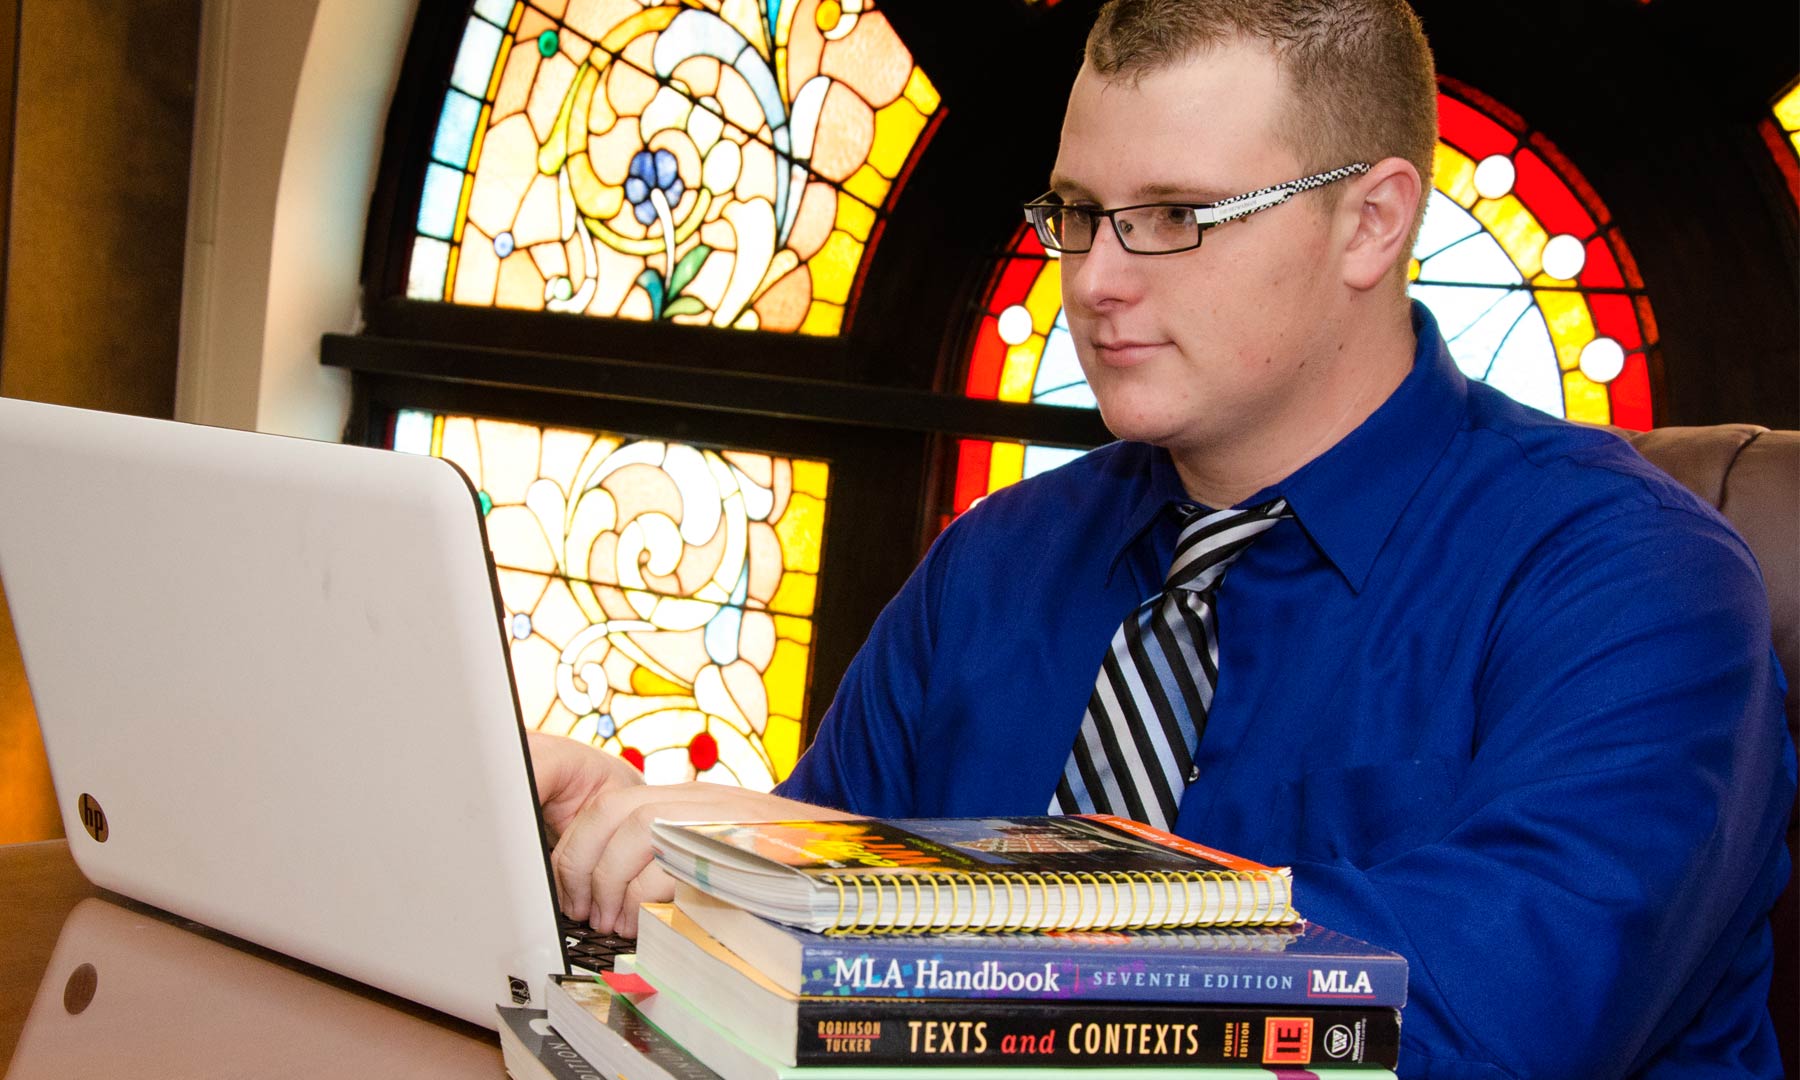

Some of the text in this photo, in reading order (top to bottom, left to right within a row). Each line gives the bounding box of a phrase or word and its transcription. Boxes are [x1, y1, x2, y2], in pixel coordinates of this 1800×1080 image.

[84, 793, 104, 841] hp
[833, 957, 1061, 992] MLA Handbook
[1092, 971, 1294, 990] SEVENTH EDITION
[1312, 969, 1373, 994] MLA
[817, 1020, 881, 1036] ROBINSON
[907, 1021, 1199, 1056] TEXTS and CONTEXTS
[1223, 1022, 1234, 1057] FOURTH
[1239, 1022, 1250, 1058] EDITION
[1276, 1027, 1301, 1053] IE
[825, 1038, 872, 1053] TUCKER
